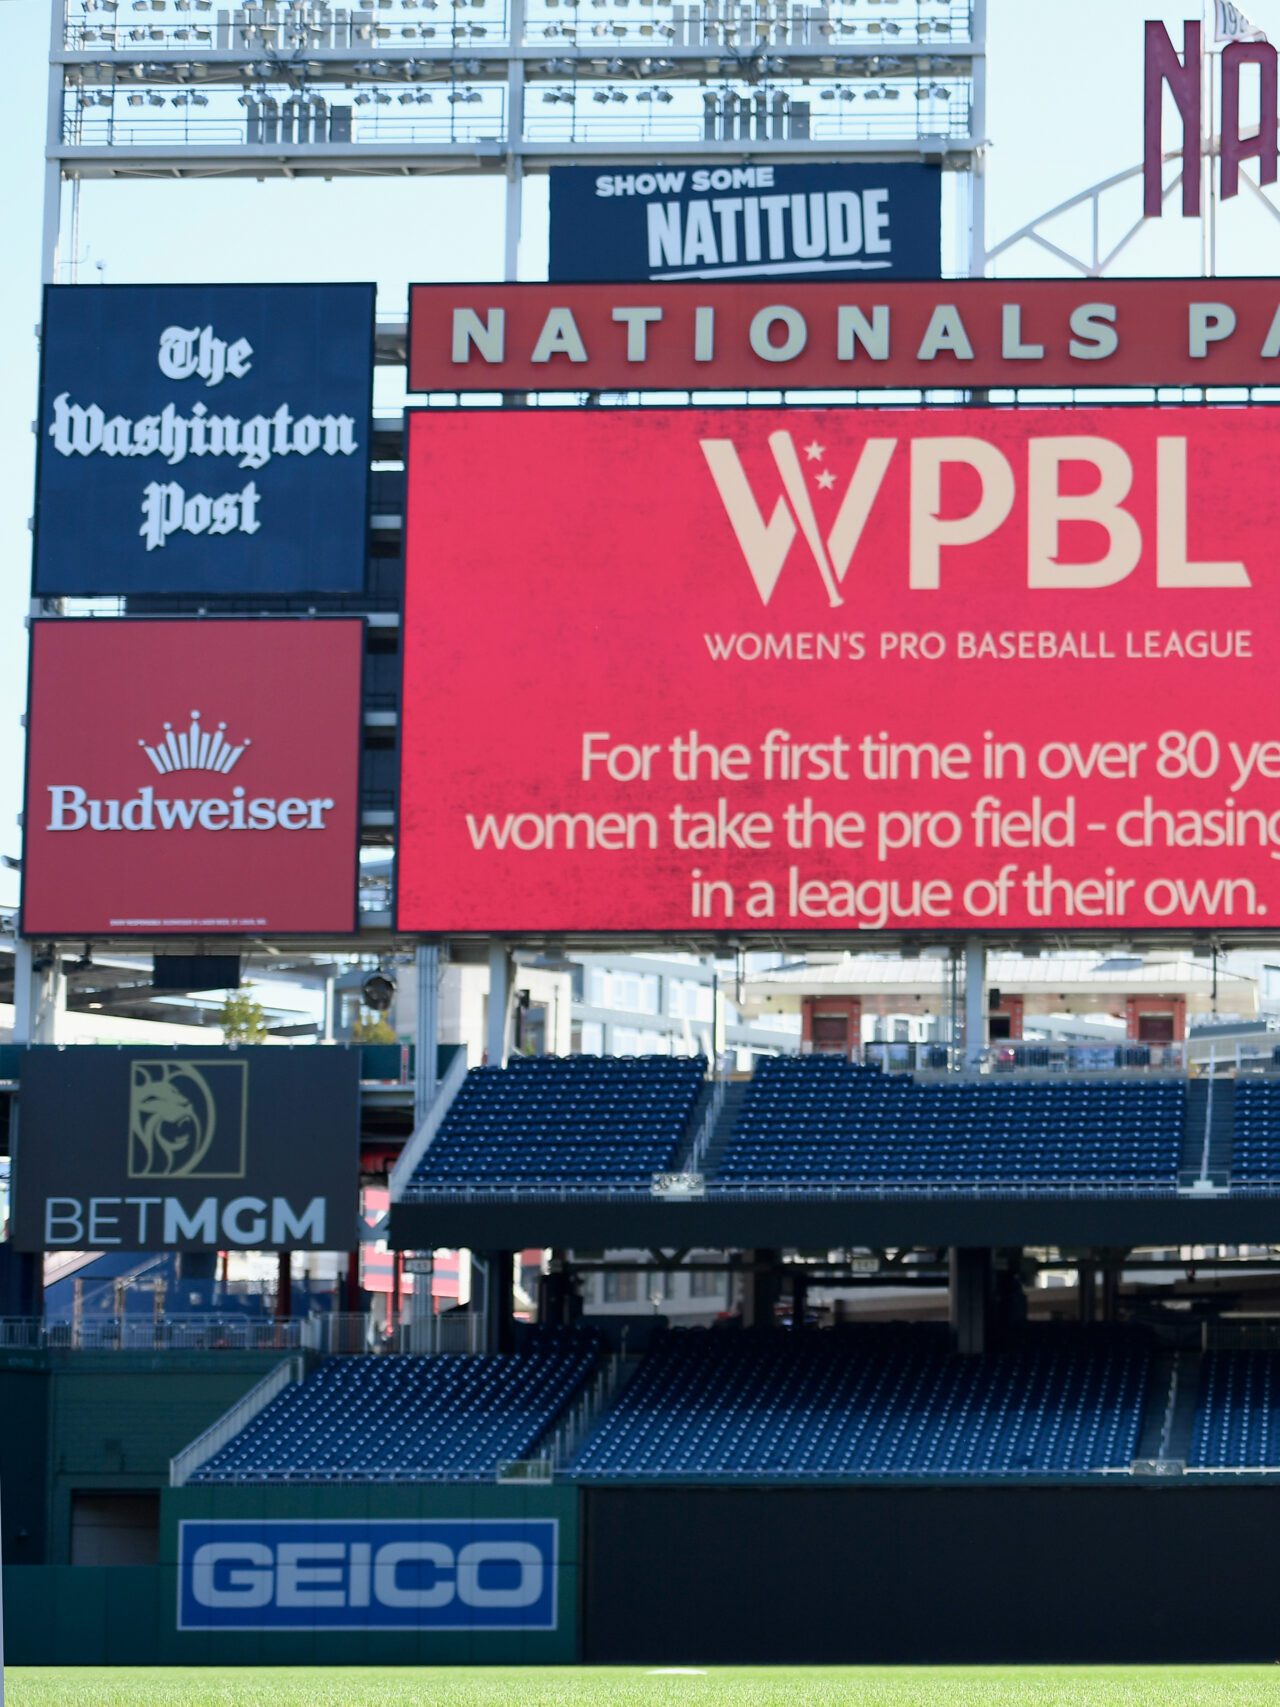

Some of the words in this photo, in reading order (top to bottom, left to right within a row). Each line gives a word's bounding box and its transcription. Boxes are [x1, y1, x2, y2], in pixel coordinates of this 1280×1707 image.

[595, 172, 686, 197] SHOW
[692, 167, 775, 192] SOME
[646, 189, 892, 267] NATITUDE
[158, 334, 254, 387] The
[452, 302, 1119, 363] NATIONALS
[48, 391, 358, 469] Washington
[139, 481, 261, 552] Post
[699, 430, 1252, 608] WPBL
[704, 632, 865, 660] WOMEN'S
[880, 632, 946, 660] PRO
[957, 631, 1115, 659] BASEBALL
[1126, 630, 1252, 658] LEAGUE
[582, 732, 660, 782] For
[668, 729, 751, 781] the
[760, 728, 849, 780] first
[859, 730, 971, 780] time
[984, 730, 1025, 779] in
[1038, 742, 1148, 779] over
[1156, 730, 1219, 779] 80
[46, 786, 334, 832] Budweiser
[466, 812, 658, 850] women
[670, 797, 773, 850] take
[782, 797, 866, 849] the
[878, 811, 962, 862] pro
[972, 796, 1075, 848] field
[1087, 823, 1106, 831] -
[692, 869, 733, 917] in
[746, 880, 774, 918] a
[789, 866, 952, 929] league
[963, 866, 1013, 916] of
[1021, 865, 1135, 917] their
[1144, 878, 1267, 916] own.
[44, 1197, 327, 1245] BETMGM
[191, 1541, 544, 1608] GEICO
